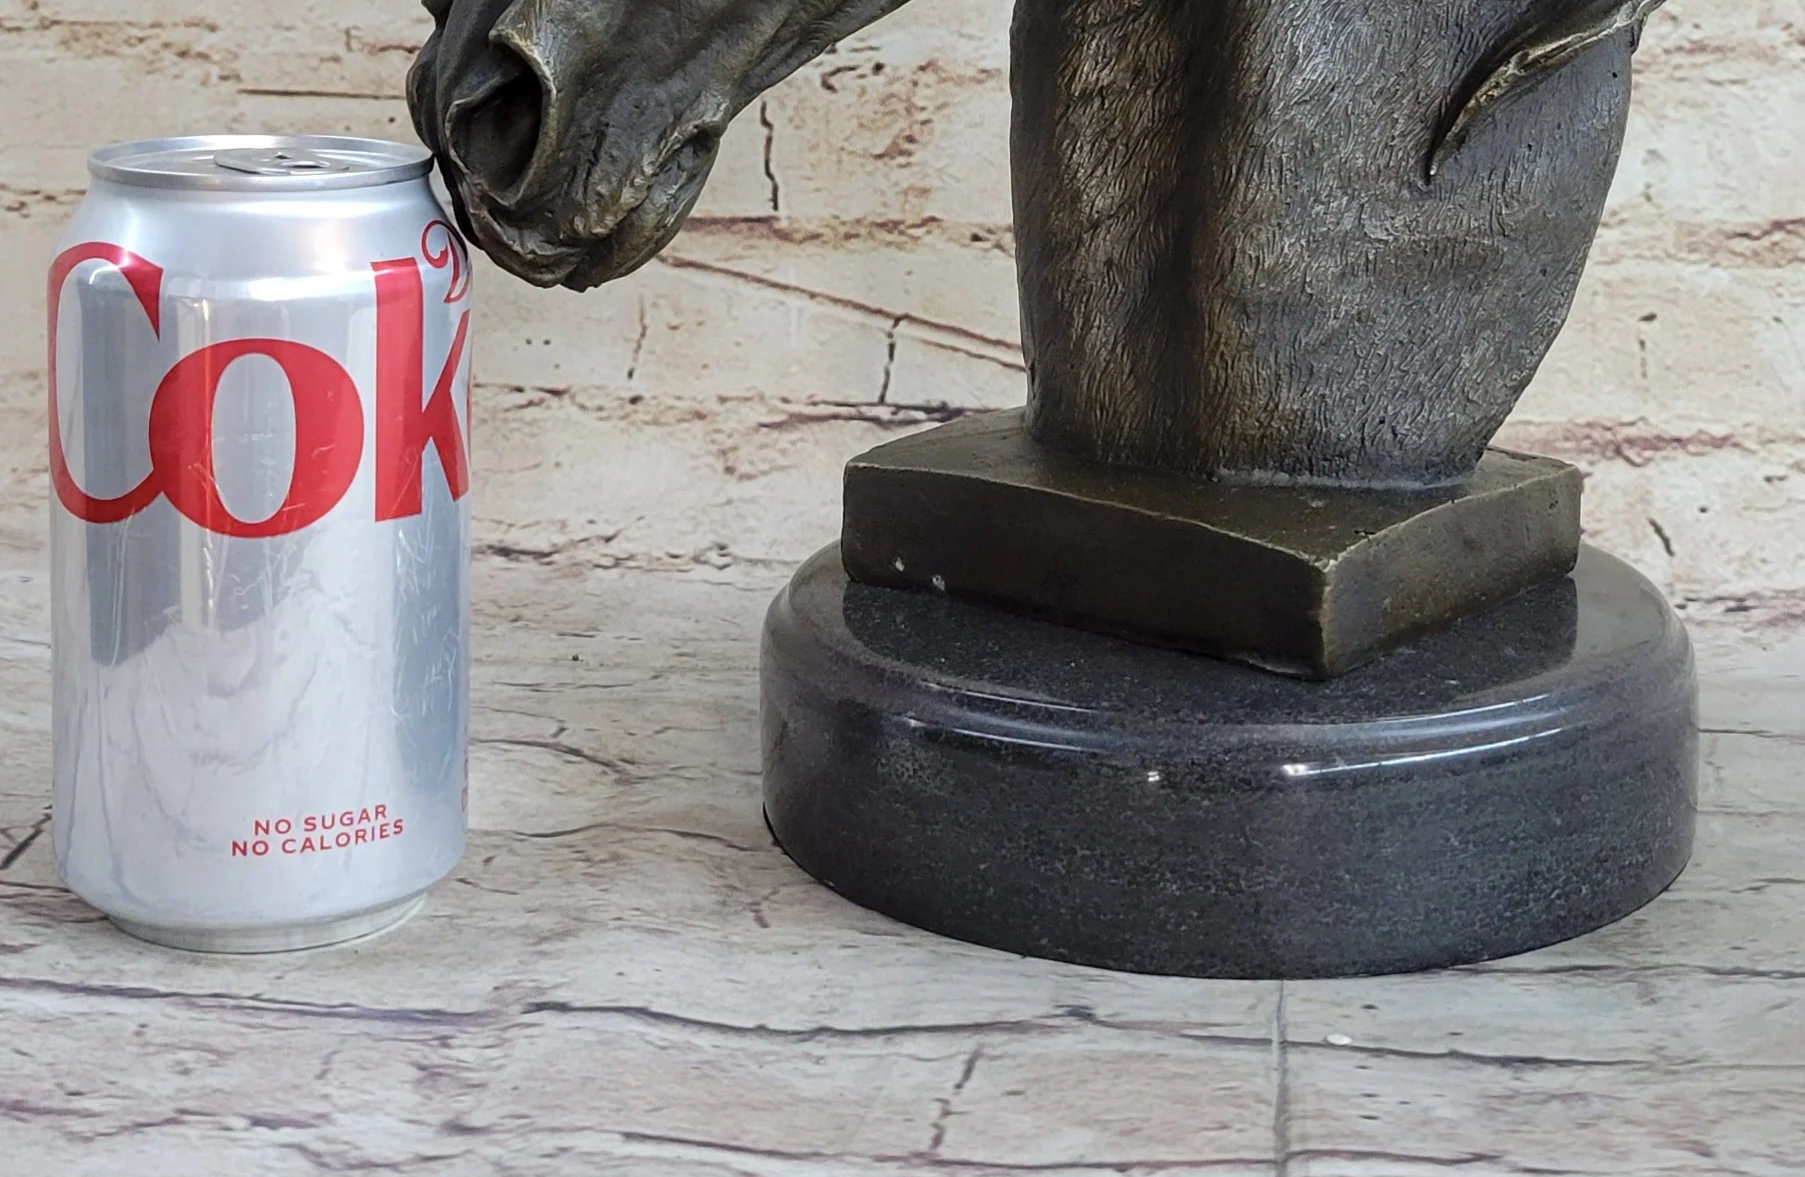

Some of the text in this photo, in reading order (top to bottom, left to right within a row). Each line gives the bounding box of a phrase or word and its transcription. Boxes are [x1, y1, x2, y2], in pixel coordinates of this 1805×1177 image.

[47, 241, 472, 539] Cok
[231, 818, 404, 857] NO CALORIES
[254, 803, 388, 836] NO SUGAR
